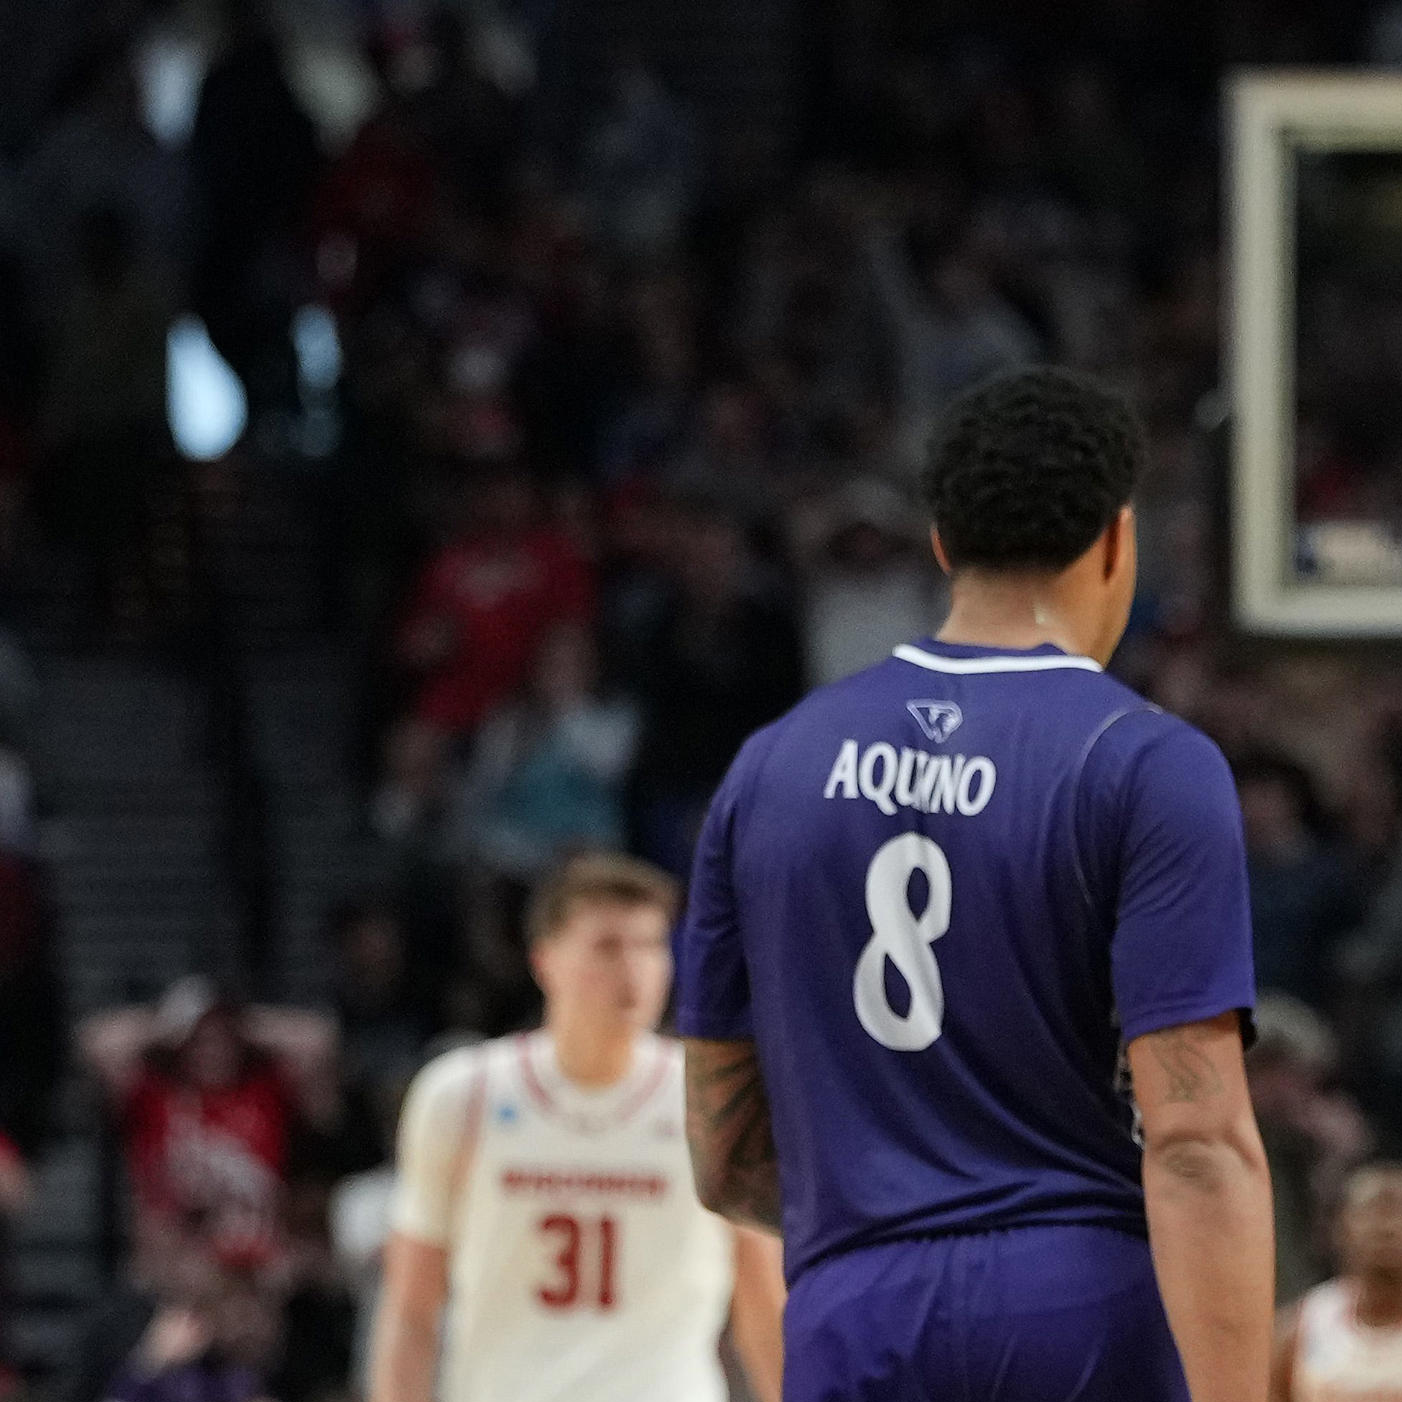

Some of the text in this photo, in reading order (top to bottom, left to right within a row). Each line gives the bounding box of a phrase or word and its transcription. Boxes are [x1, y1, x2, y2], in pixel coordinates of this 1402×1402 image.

[824, 738, 996, 816] AQUINO
[852, 831, 952, 1051] 8
[538, 1212, 619, 1309] 31
